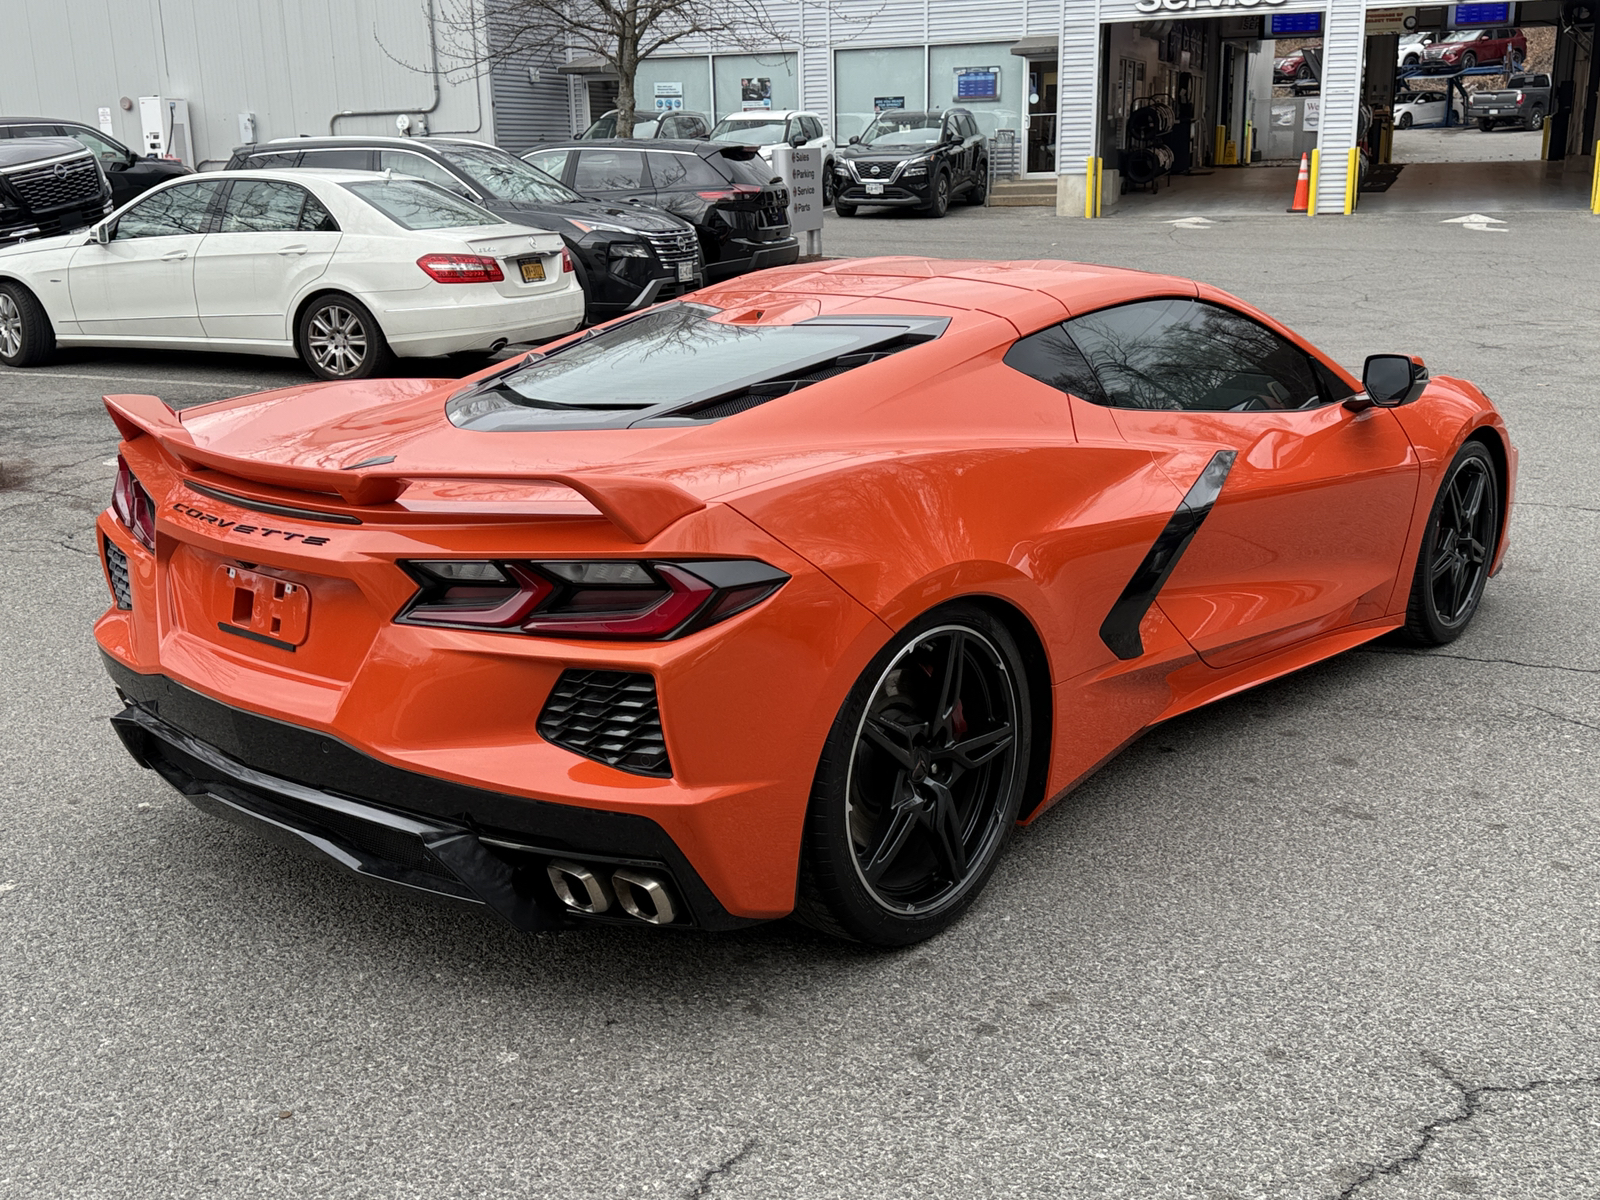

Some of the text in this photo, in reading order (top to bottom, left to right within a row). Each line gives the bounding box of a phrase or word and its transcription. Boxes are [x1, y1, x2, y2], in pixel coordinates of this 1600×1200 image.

[795, 153, 809, 162] Sales
[796, 169, 815, 180] Parking
[797, 186, 815, 196] Service
[798, 203, 811, 212] Parts
[172, 502, 331, 547] CORVETTE
